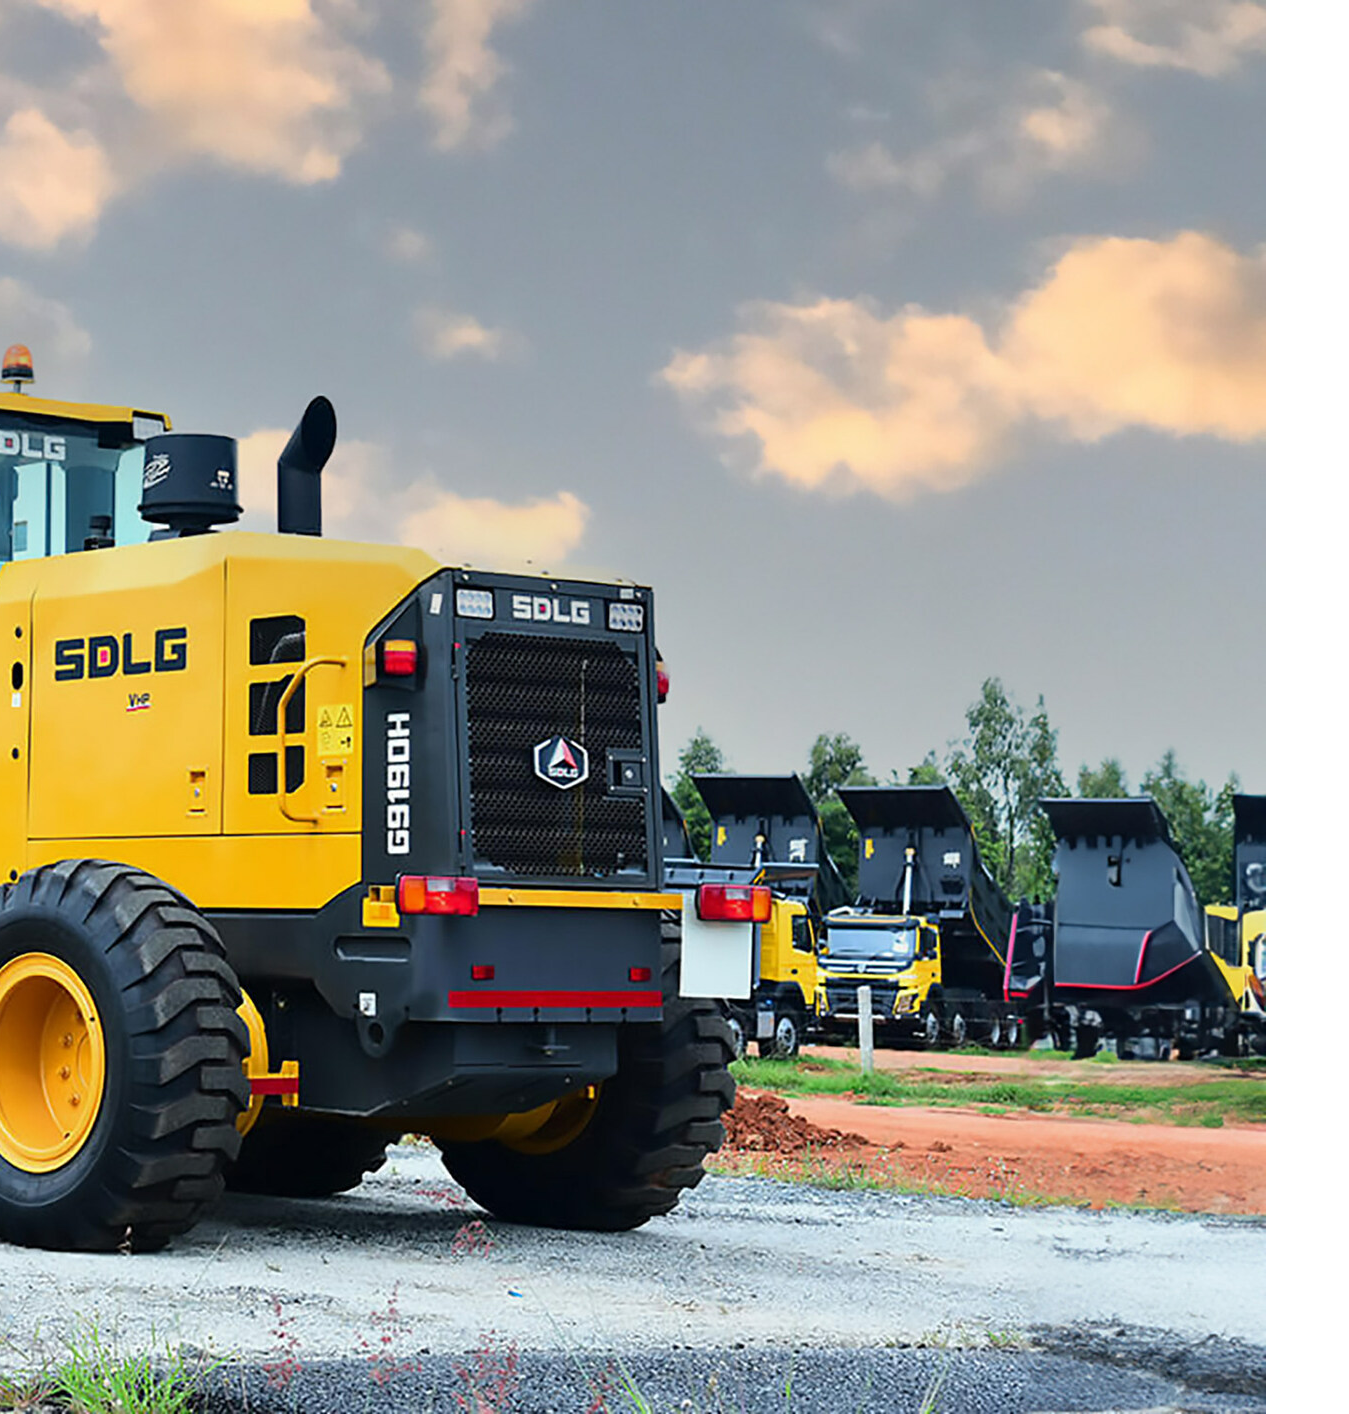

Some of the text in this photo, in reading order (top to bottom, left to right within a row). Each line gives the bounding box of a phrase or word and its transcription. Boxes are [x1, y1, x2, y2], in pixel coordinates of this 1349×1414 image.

[513, 594, 590, 624] SDLG
[54, 627, 187, 681] SDLG
[387, 712, 410, 854] G9190H
